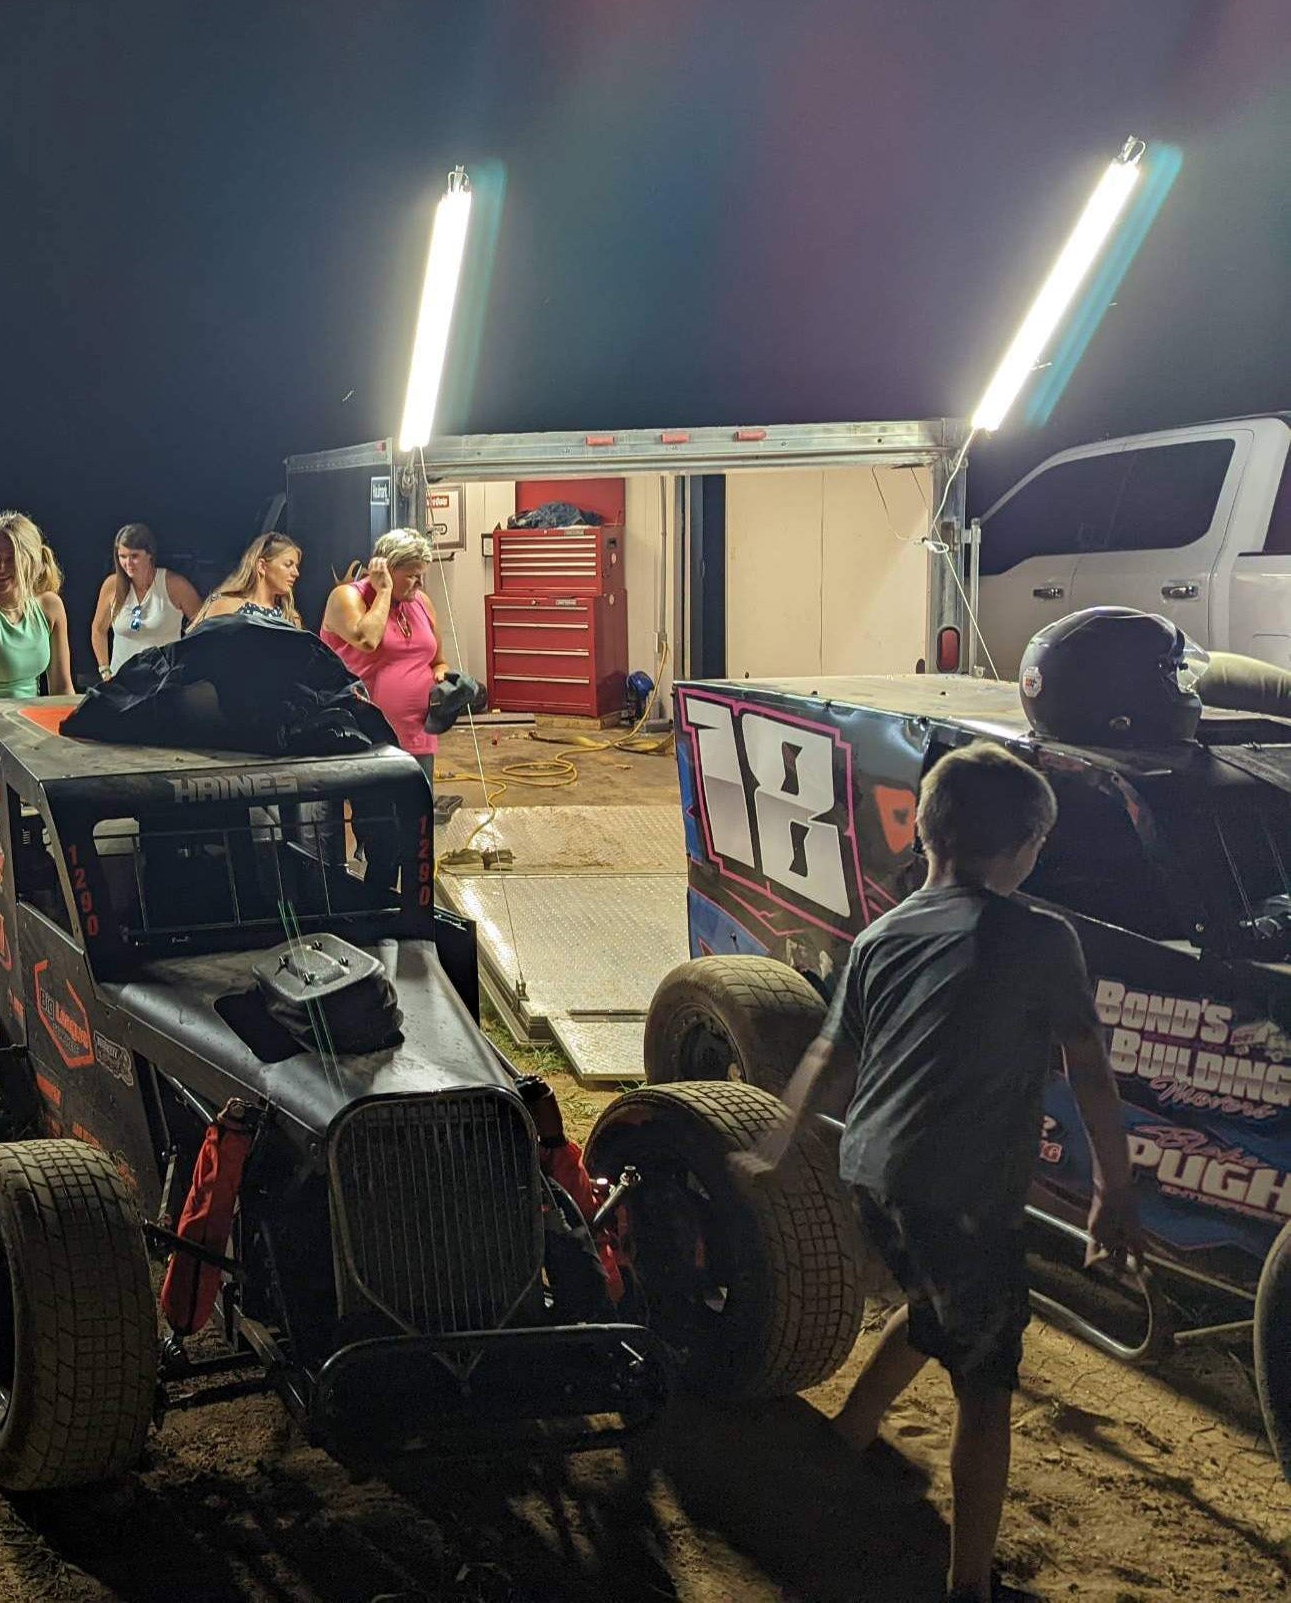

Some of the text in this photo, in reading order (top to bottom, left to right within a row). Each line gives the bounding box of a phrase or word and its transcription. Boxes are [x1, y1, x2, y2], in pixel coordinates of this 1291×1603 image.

[167, 770, 299, 803] HAINES
[69, 844, 100, 938] 1290
[417, 814, 431, 907] 1290
[1110, 1027, 1291, 1107] BUILDING
[1127, 1134, 1291, 1215] PUGH
